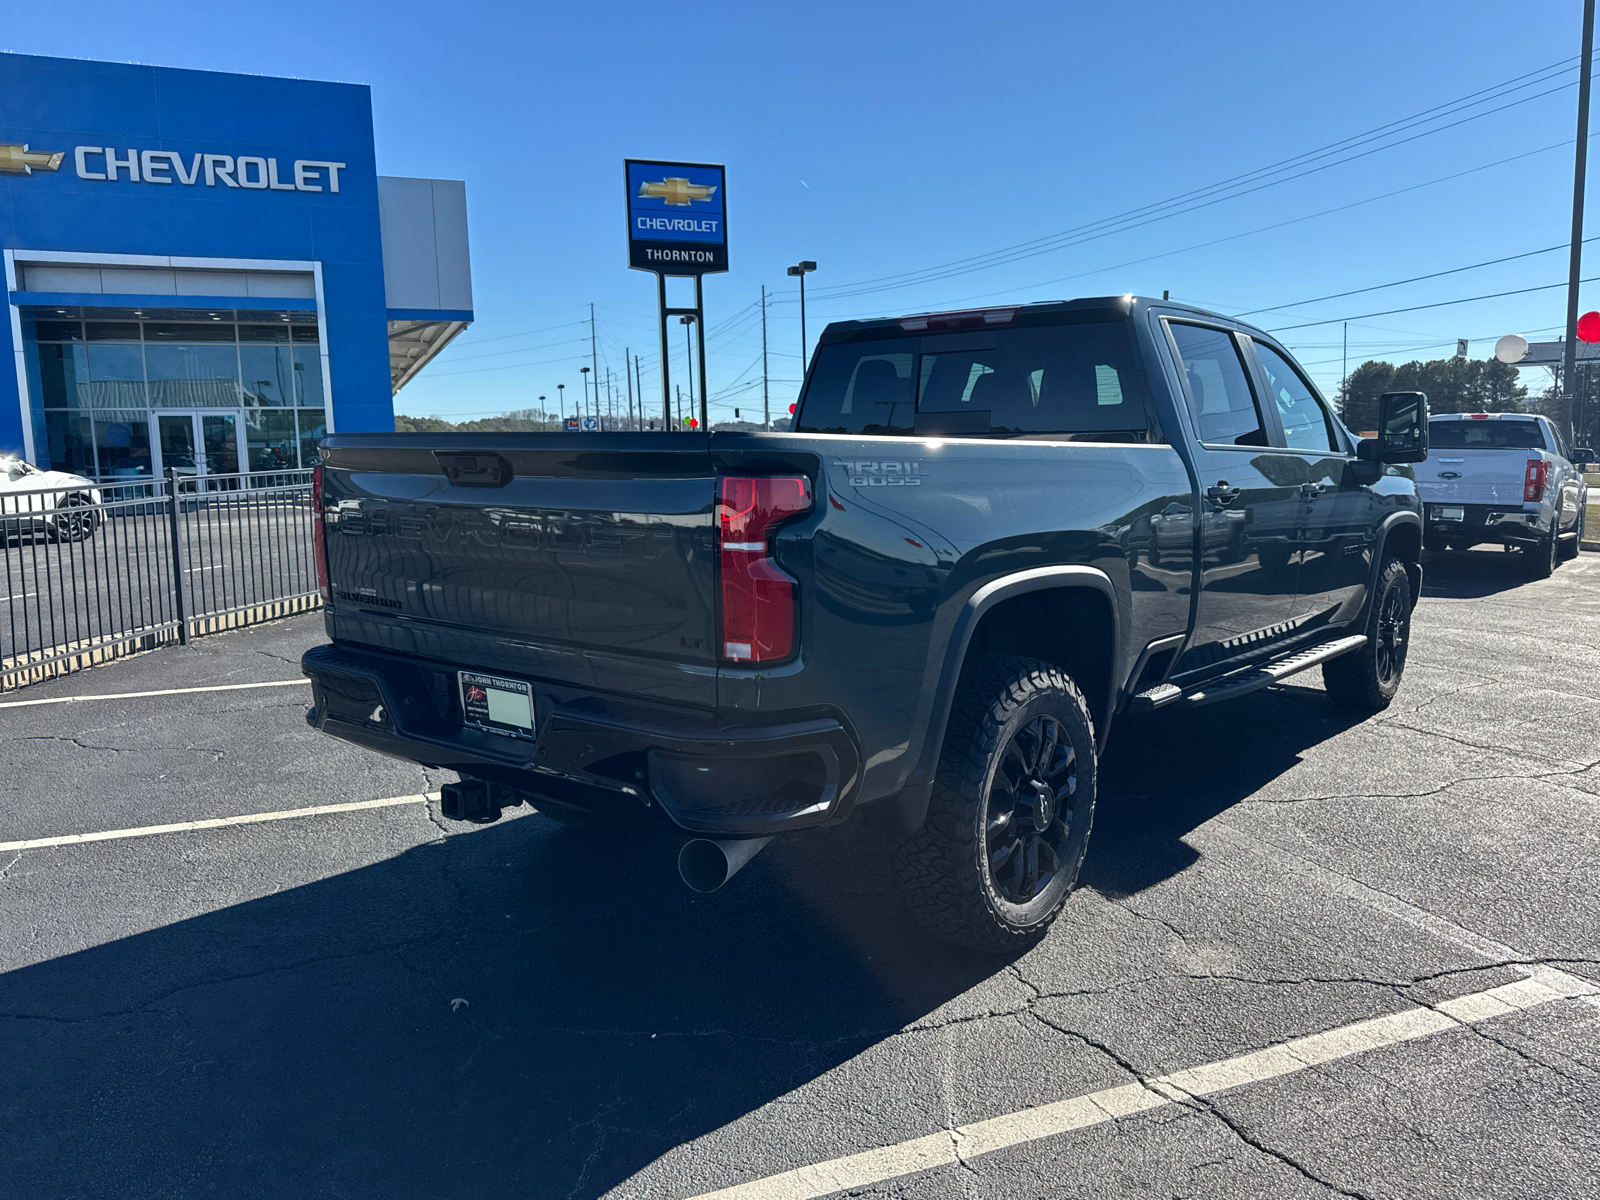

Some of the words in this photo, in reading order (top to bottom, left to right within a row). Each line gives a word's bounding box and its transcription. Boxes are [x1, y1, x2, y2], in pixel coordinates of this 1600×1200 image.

[74, 145, 346, 193] CHEVROLET
[637, 217, 718, 232] CHEVROLET
[646, 248, 714, 262] THORNTON
[832, 461, 932, 476] TRAIL
[849, 476, 921, 487] BOSS
[340, 509, 674, 559] CHEVROLET
[474, 676, 491, 685] JOHN
[492, 679, 527, 692] THORNTON
